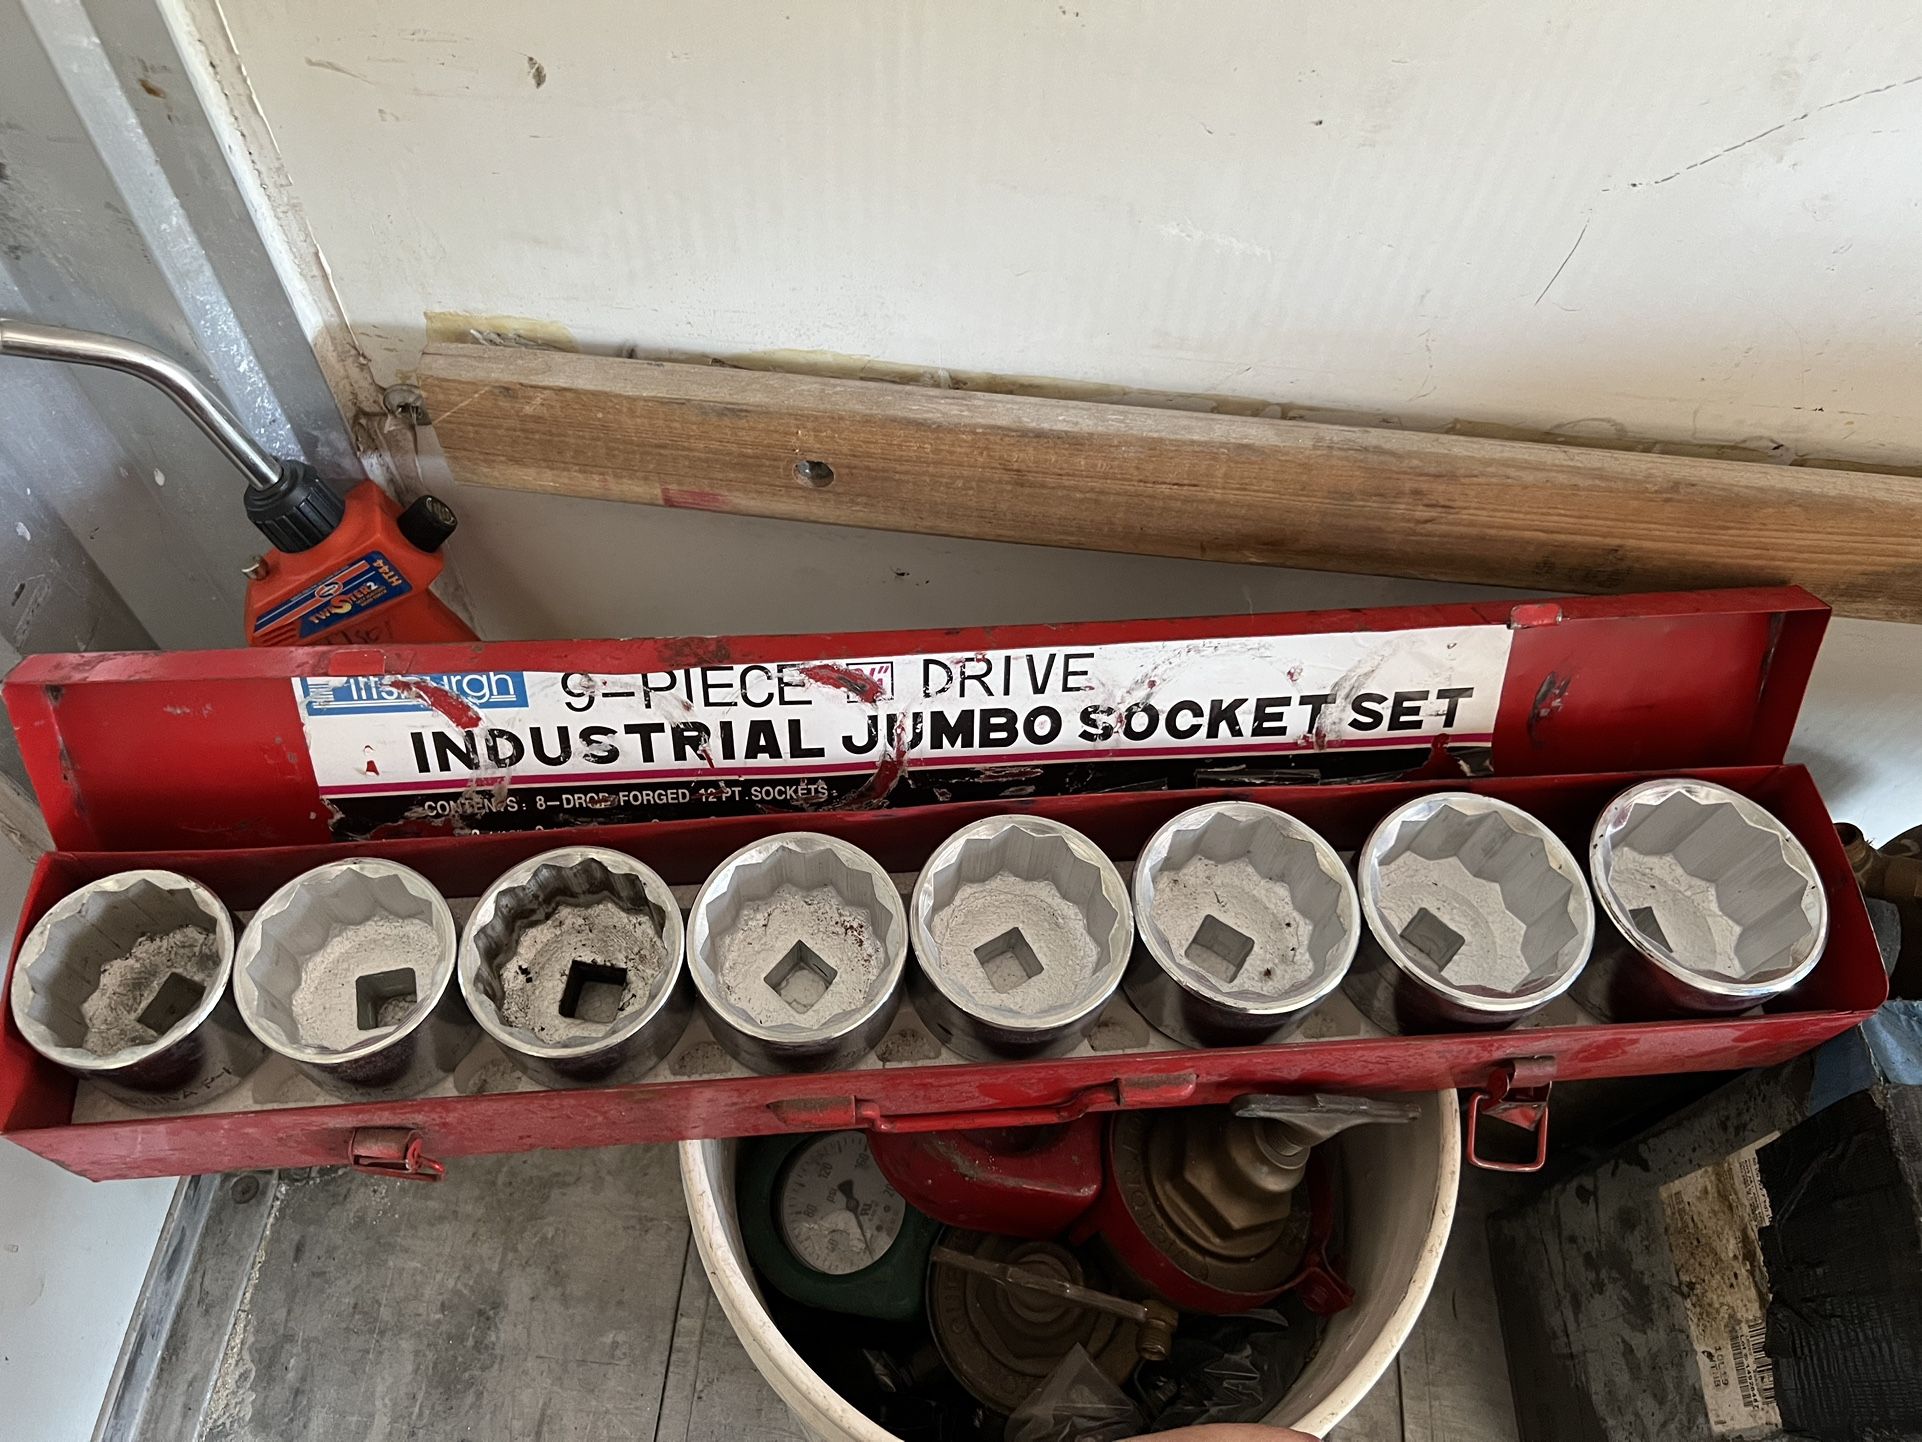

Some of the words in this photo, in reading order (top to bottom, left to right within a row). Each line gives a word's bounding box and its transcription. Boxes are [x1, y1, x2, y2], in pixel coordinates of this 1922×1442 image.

[923, 653, 1095, 698] DRIVE
[410, 719, 825, 774] INDUSTRIAL
[842, 706, 1062, 755] JUMBO
[1078, 693, 1336, 742] SOCKET
[1347, 687, 1474, 732] SET
[619, 788, 690, 806] FORGED
